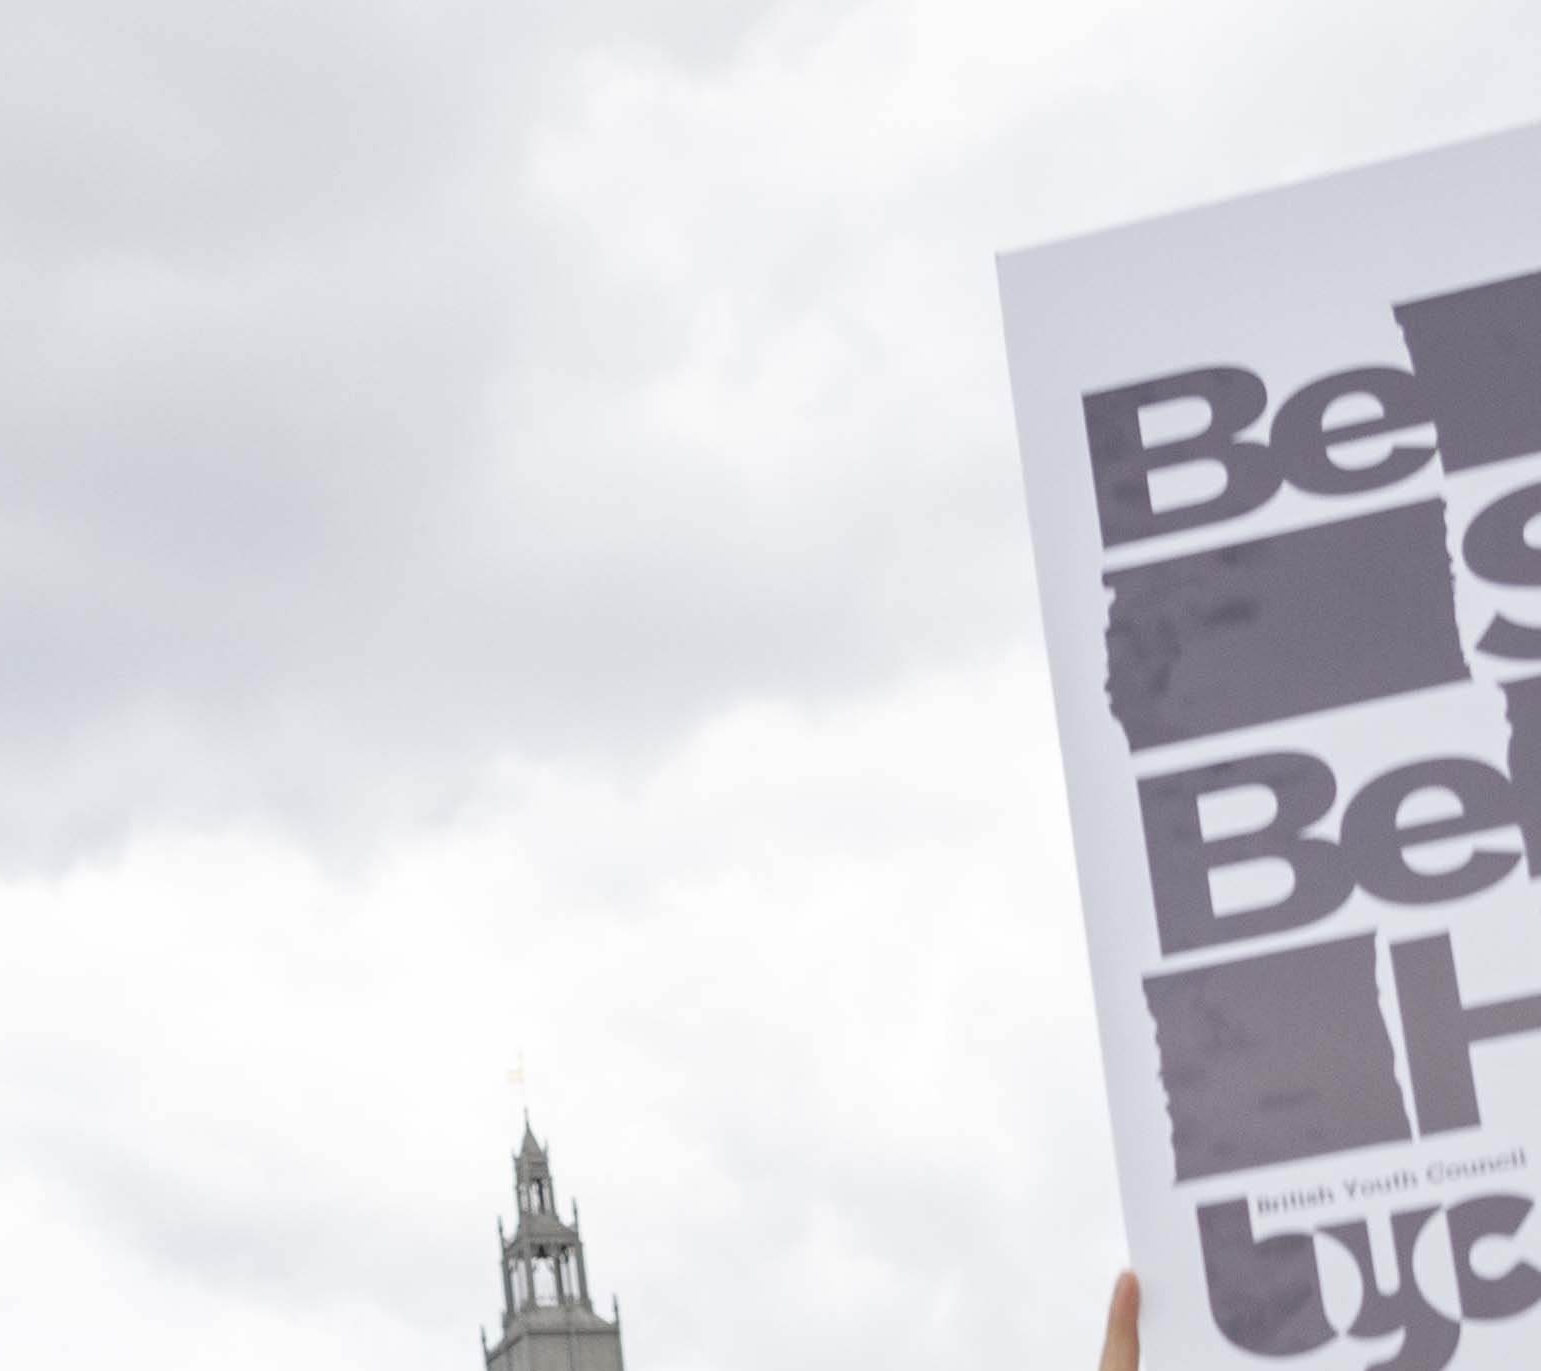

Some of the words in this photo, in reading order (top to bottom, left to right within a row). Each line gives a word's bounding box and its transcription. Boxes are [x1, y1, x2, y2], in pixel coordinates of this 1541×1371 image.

[1082, 363, 1438, 551] Be
[1136, 748, 1523, 958] Be
[1257, 1184, 1335, 1214] British
[1343, 1166, 1418, 1198] Youth
[1426, 1148, 1528, 1186] Council
